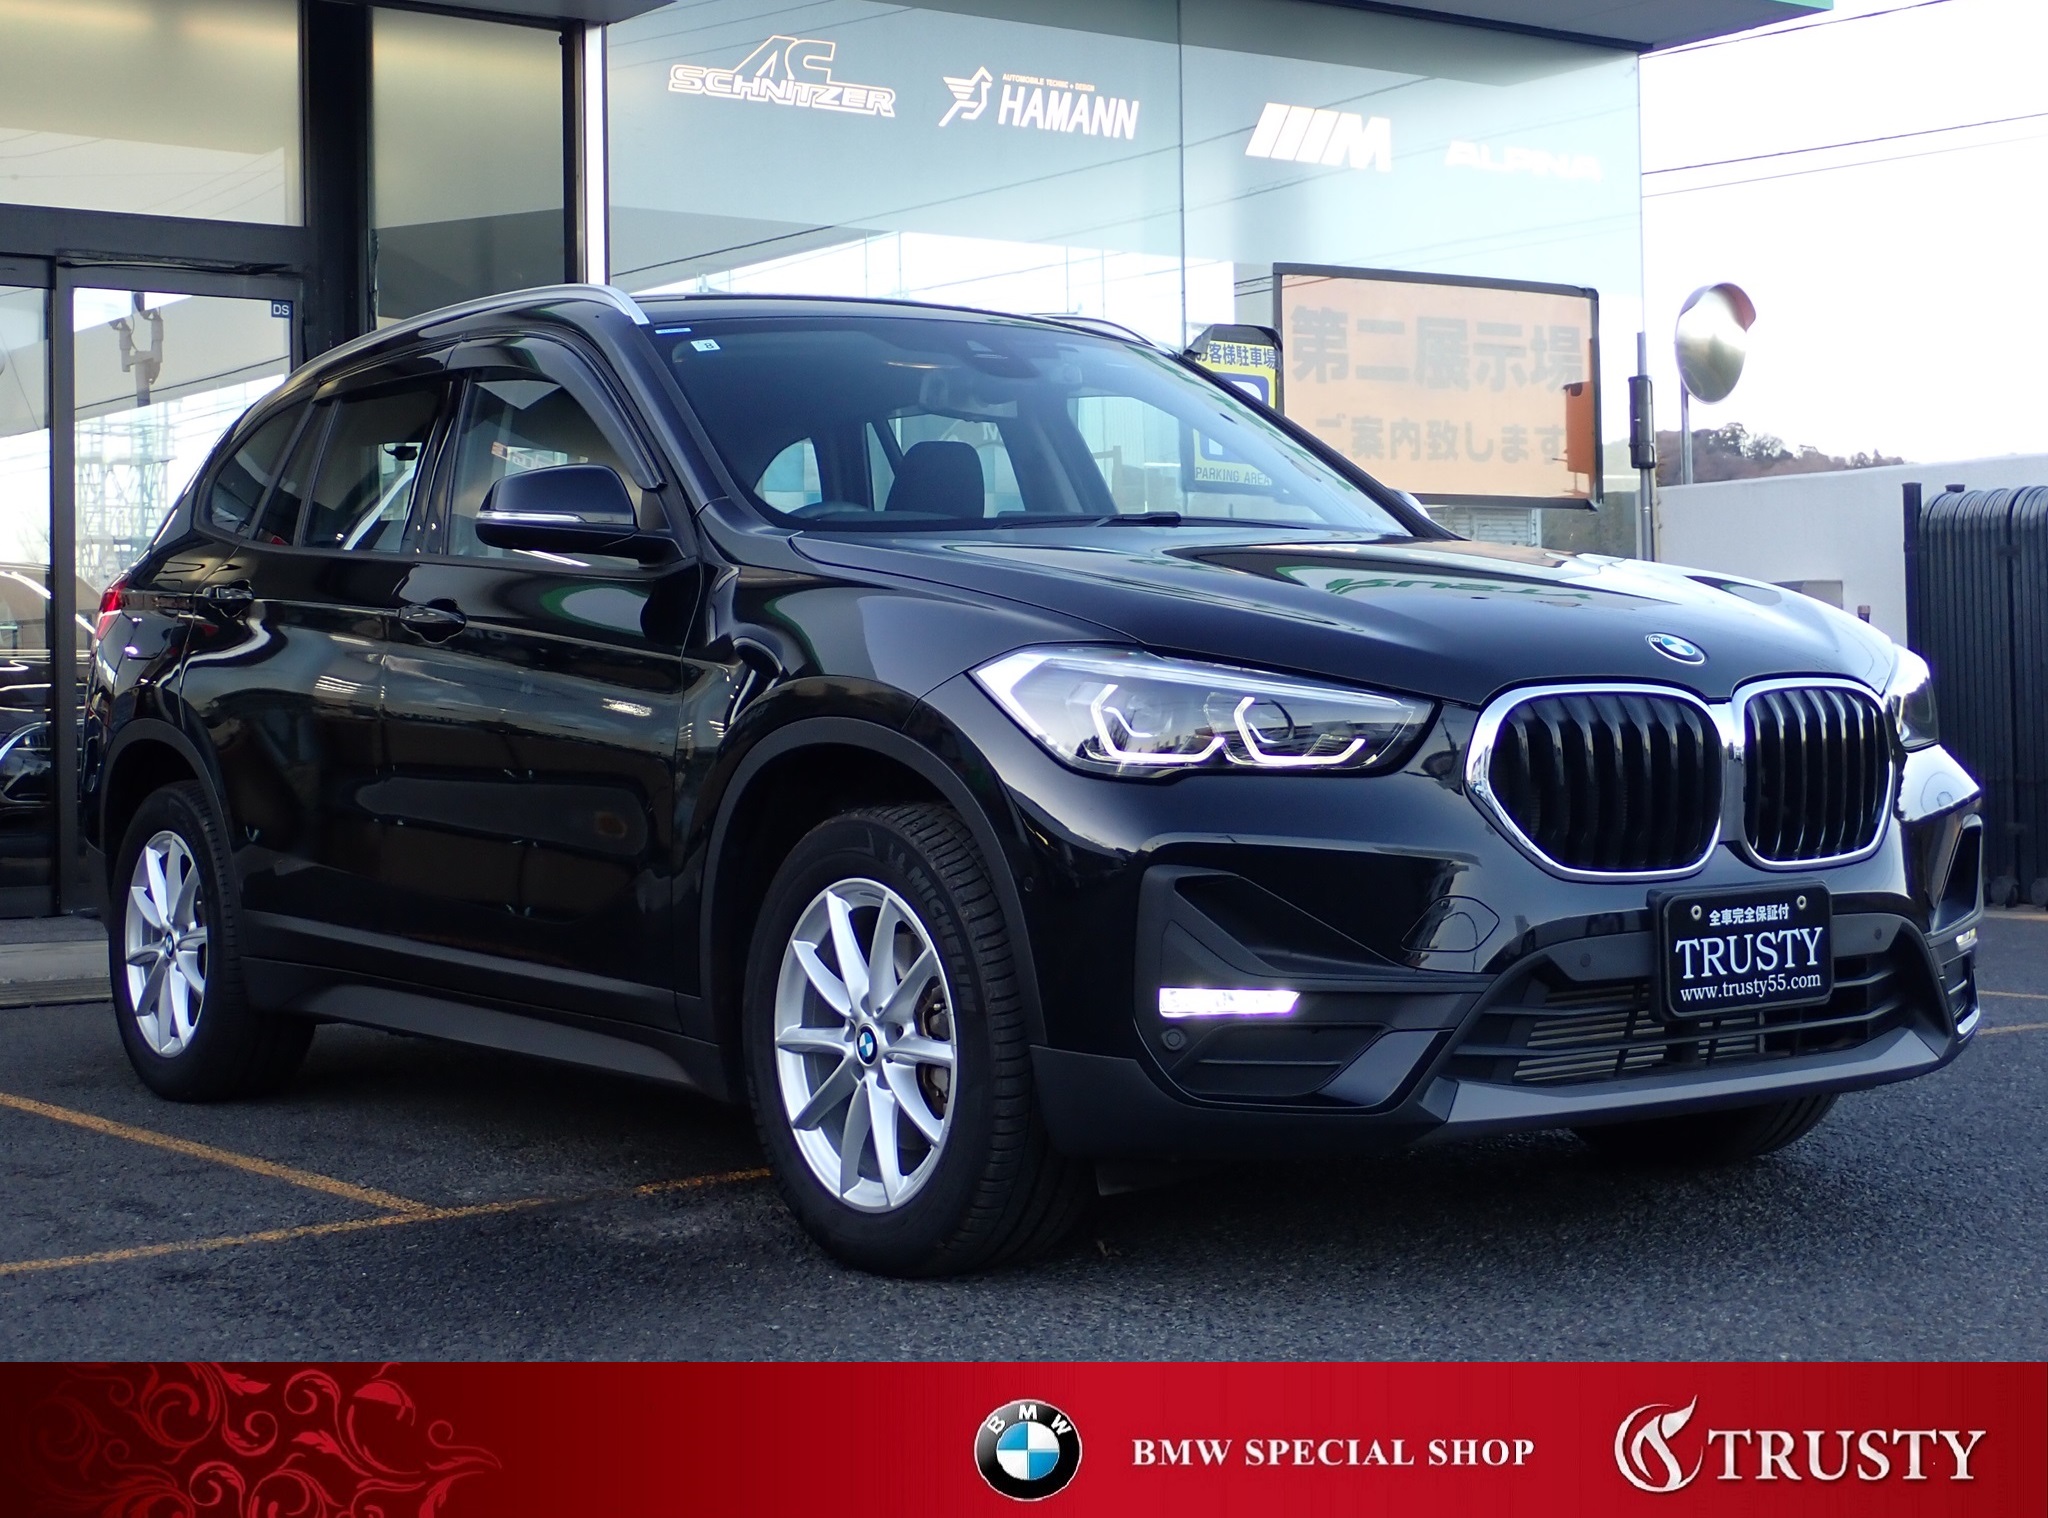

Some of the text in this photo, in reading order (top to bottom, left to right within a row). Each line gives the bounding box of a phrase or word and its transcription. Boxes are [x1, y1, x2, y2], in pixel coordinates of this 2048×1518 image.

[733, 34, 836, 82] AC
[668, 64, 896, 117] SCHNITZER
[998, 84, 1139, 140] HAMANN
[1445, 140, 1603, 182] ALPINA
[273, 304, 290, 315] DS
[1291, 305, 1583, 392] 第二展示場
[1195, 467, 1270, 486] PARKING AREA
[1709, 903, 1789, 926] 全車完全保証付
[907, 866, 978, 1012] MICHELIN
[1675, 927, 1823, 979] TRUSTY
[1680, 973, 1821, 1002] www.trusty55.com
